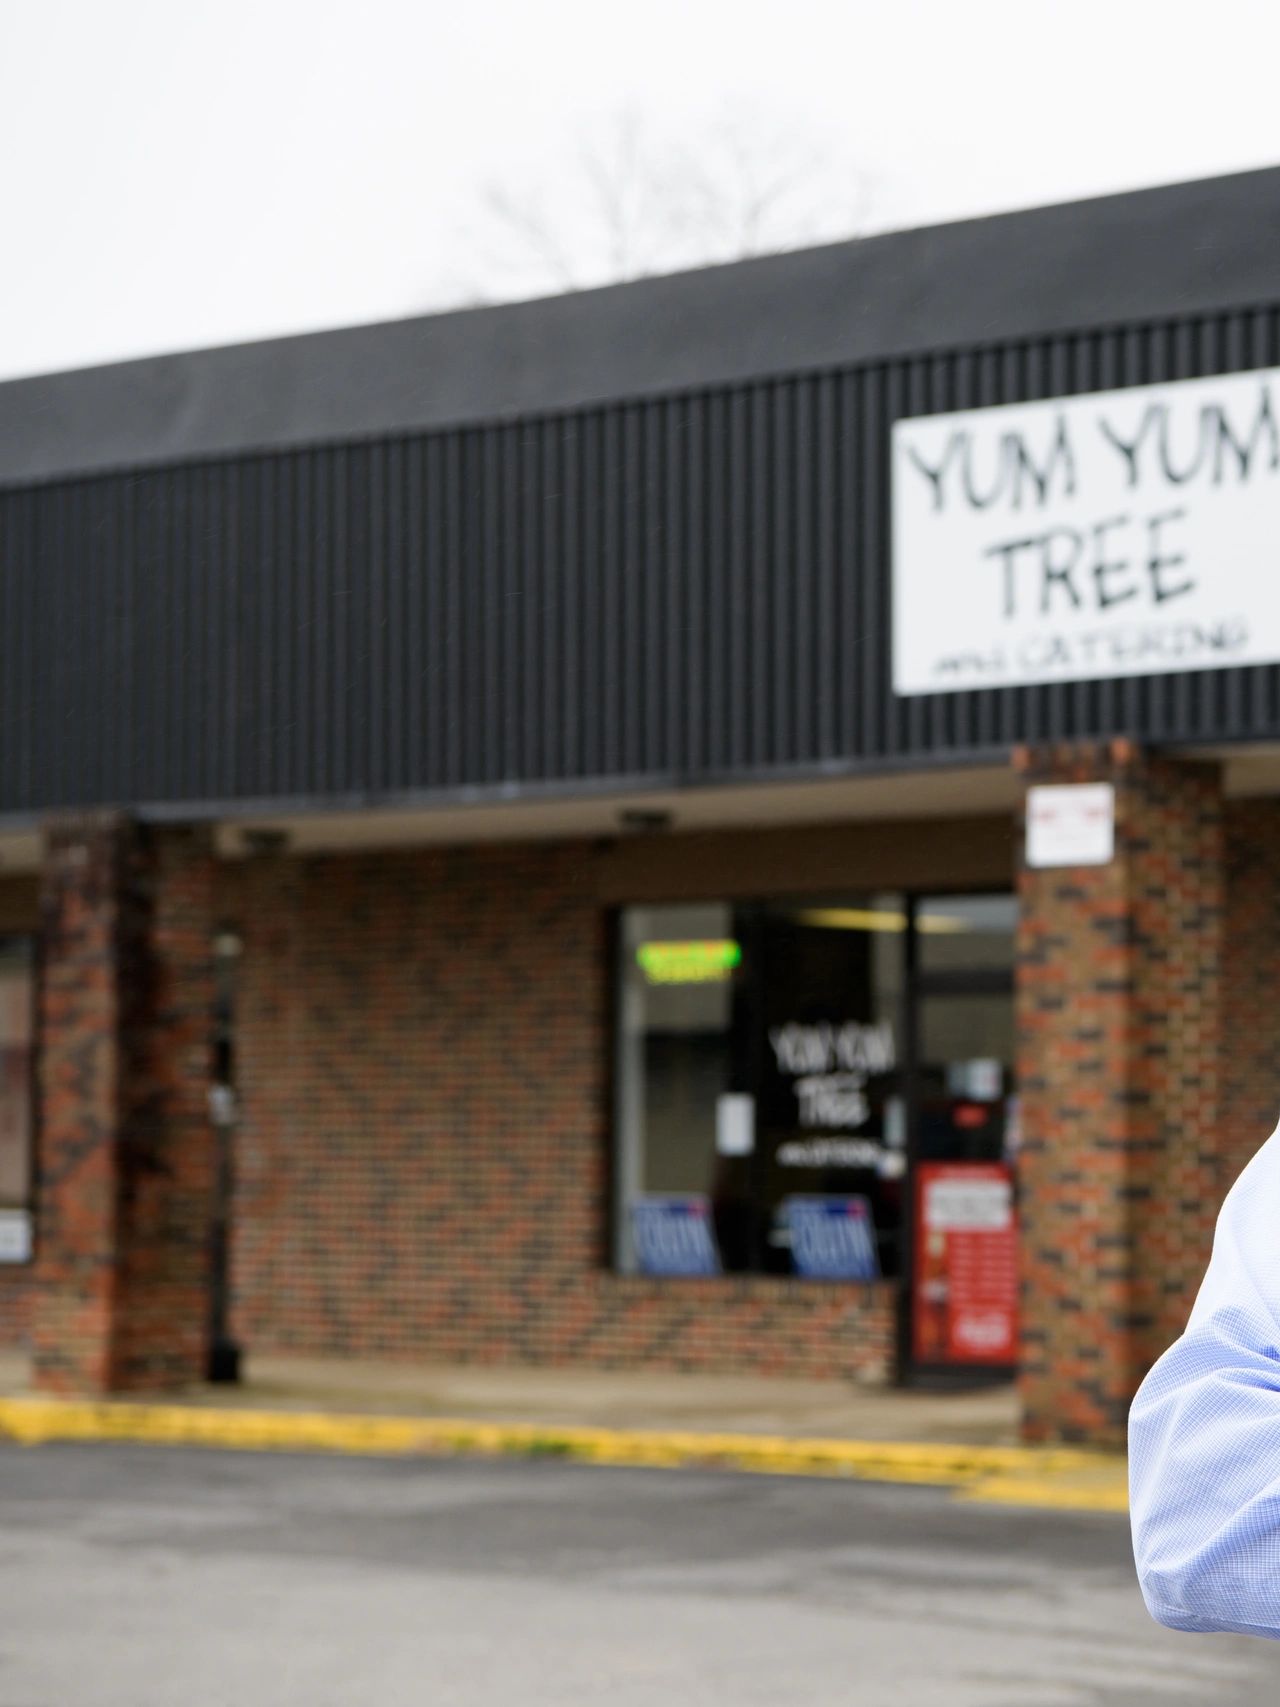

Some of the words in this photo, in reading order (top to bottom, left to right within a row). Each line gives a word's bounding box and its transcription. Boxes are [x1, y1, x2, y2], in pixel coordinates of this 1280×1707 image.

[907, 411, 1077, 514] YUM
[1097, 380, 1280, 489] YUM
[984, 506, 1196, 619] TREE
